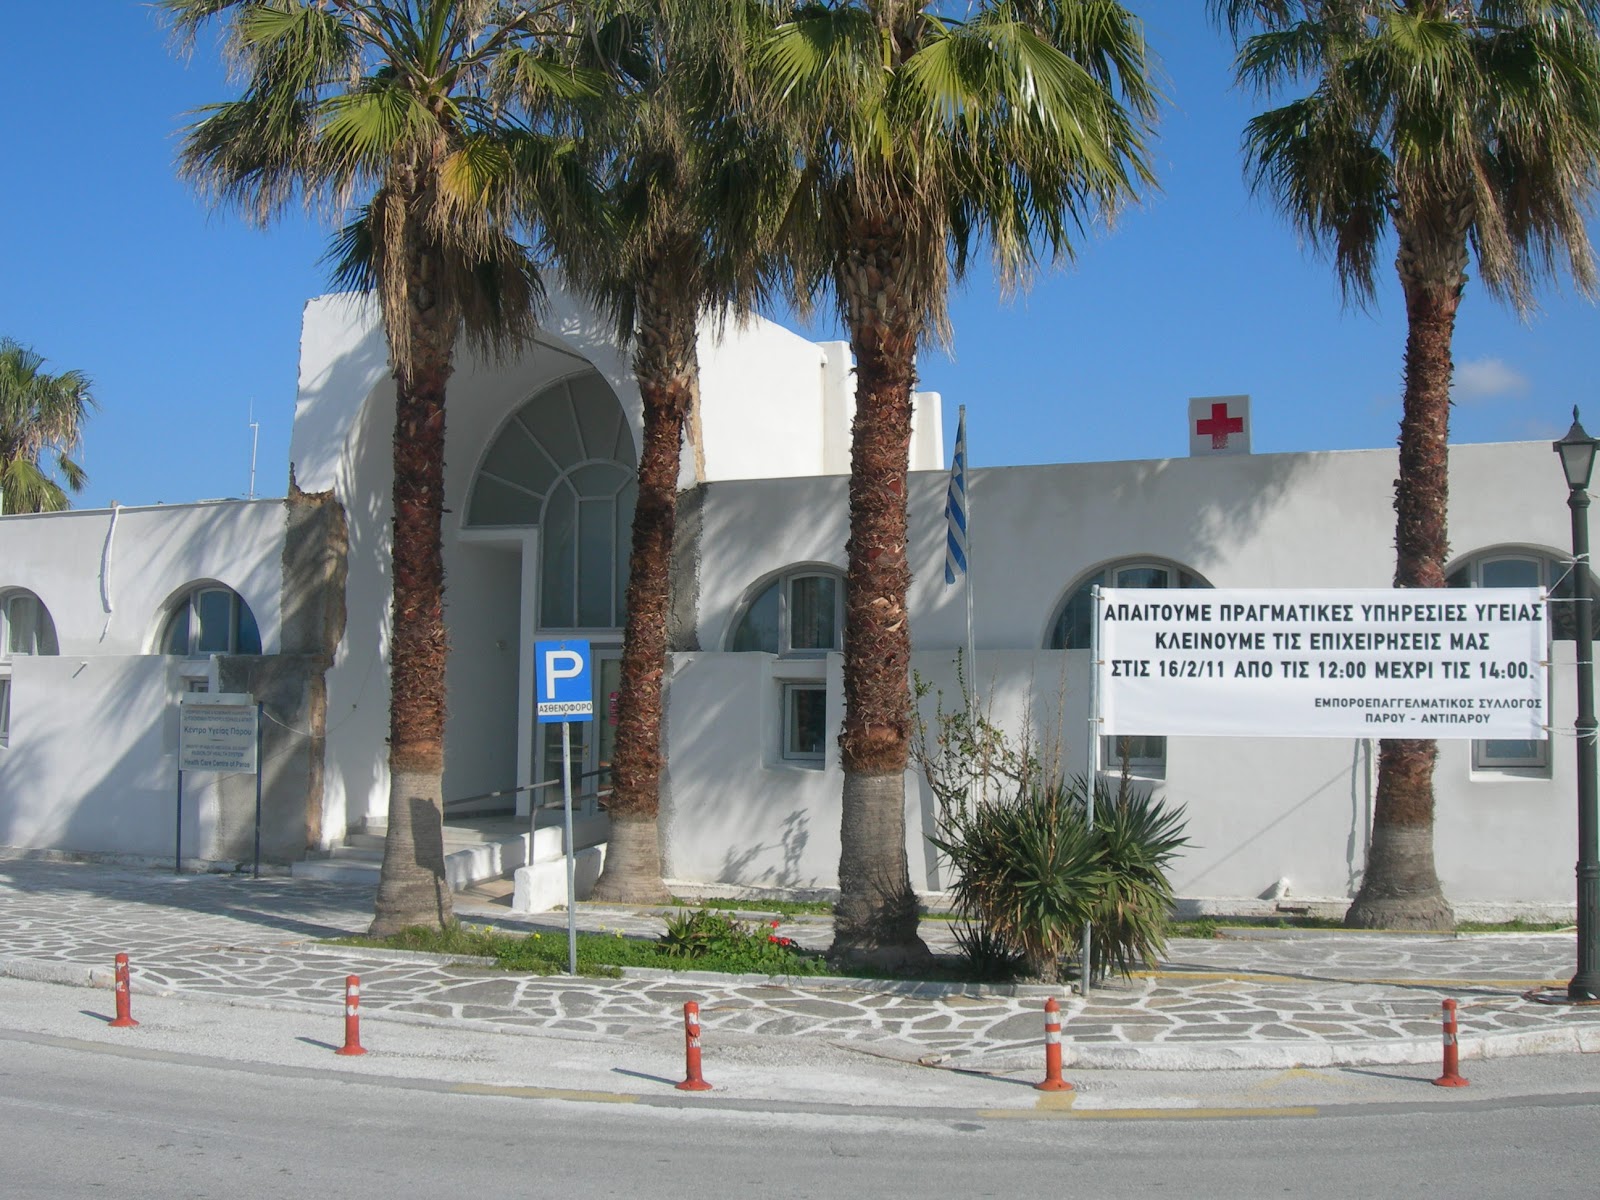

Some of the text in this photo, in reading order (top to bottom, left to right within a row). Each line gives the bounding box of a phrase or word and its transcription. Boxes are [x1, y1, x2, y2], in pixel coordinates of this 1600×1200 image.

[1104, 604, 1543, 622] ΑΠΑΙΤΟΥΜΕ ΠΡΑΓΜΑΤΙΚΕΣ ΥΠΗΡΕΣΙΕΣ ΥΓΕΙΑΣ
[1155, 632, 1490, 650] ΚΛΕΙΝΟΥΜΕ ΤΙΣ ΕΠΙΧΕΙΡΗΣΕΙΣ ΜΑΣ
[546, 651, 583, 699] P
[1111, 659, 1535, 679] ΣΤΙΣ 16/2/11 ΑΠΟ ΤΙΣ 12:00 ΜΕΧΡΙ ΤΙΣ 14:00.
[539, 703, 592, 712] ΑΣΘΕΝΟΦΟΡΟ
[1314, 698, 1542, 709] ΕΜΠΟΡΟΕΠΑΓΓΕΛΜΑΤΙΚΟΣ ΣΥΛΛΟΓΟΣ
[1365, 713, 1406, 723] ΠΑΡΟΥ
[1421, 713, 1491, 724] ΑΝΤΙΠΑΡΟΥ
